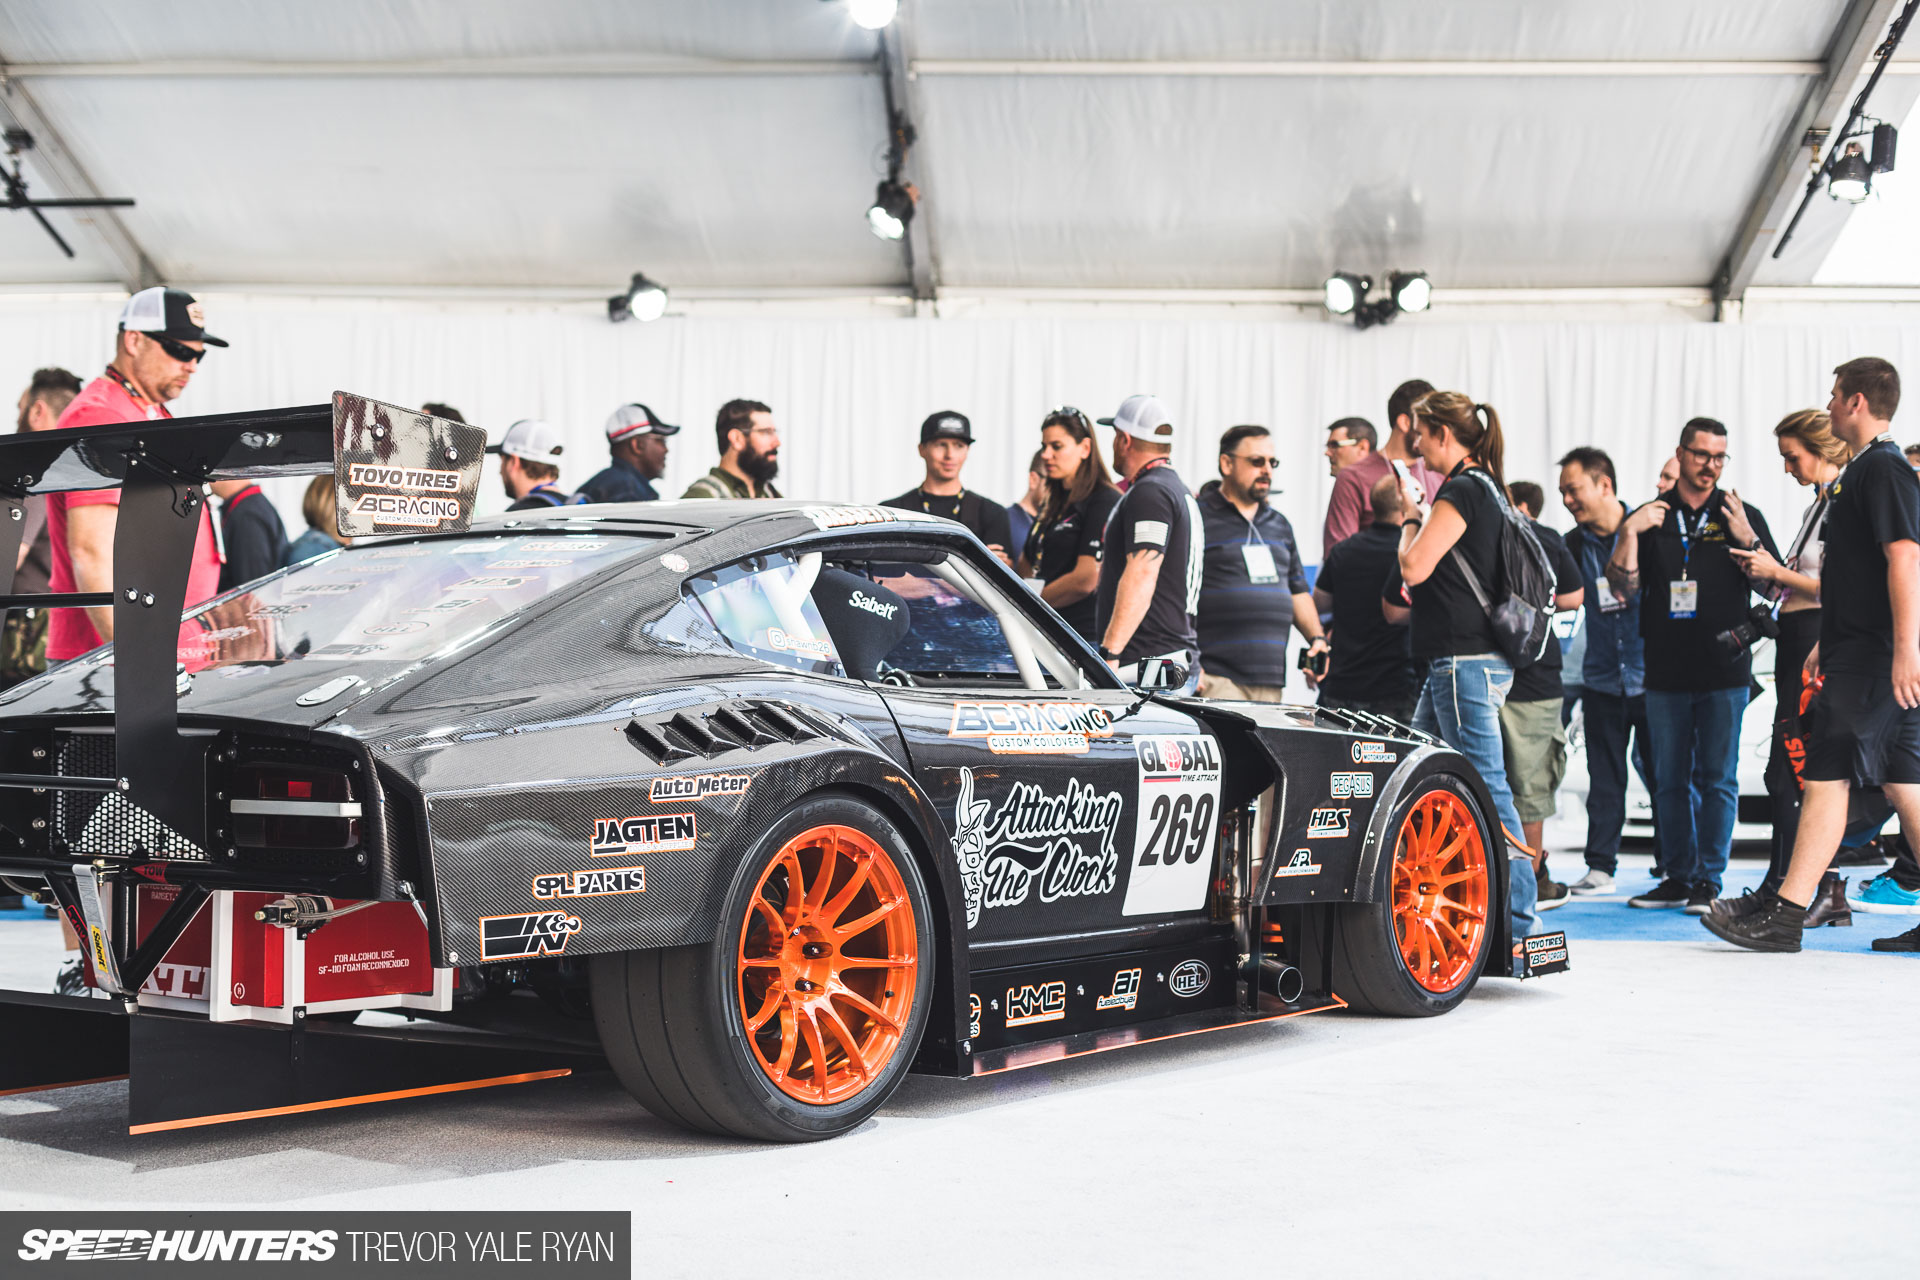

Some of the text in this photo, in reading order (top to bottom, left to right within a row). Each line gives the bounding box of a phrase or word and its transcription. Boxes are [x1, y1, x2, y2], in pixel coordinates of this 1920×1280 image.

[352, 467, 459, 489] TOYO TIRES
[849, 590, 898, 620] Sabelt
[991, 737, 1086, 748] CUSTOM COILOVERS
[1138, 739, 1219, 773] GLOBAL
[653, 776, 748, 796] Auto Meter
[1181, 774, 1219, 782] TIME ATTACK
[1334, 775, 1370, 792] PEGASUS
[984, 778, 1122, 851] Attacking
[1310, 810, 1350, 830] HPS
[593, 814, 695, 845] JAGTEN
[1138, 793, 1214, 866] 269
[144, 865, 164, 876] TOW
[985, 837, 1118, 907] The Clock
[536, 870, 644, 896] SPL PARTS
[93, 930, 105, 967] Sabelt
[1527, 936, 1563, 950] TOYO TIRES
[318, 959, 409, 974] SF-110 FOAM RECOMMENDED
[334, 950, 395, 963] FOR ALCOHOL USE
[1113, 970, 1141, 995] ai
[1177, 974, 1204, 989] HEL
[1007, 983, 1065, 1017] KMC
